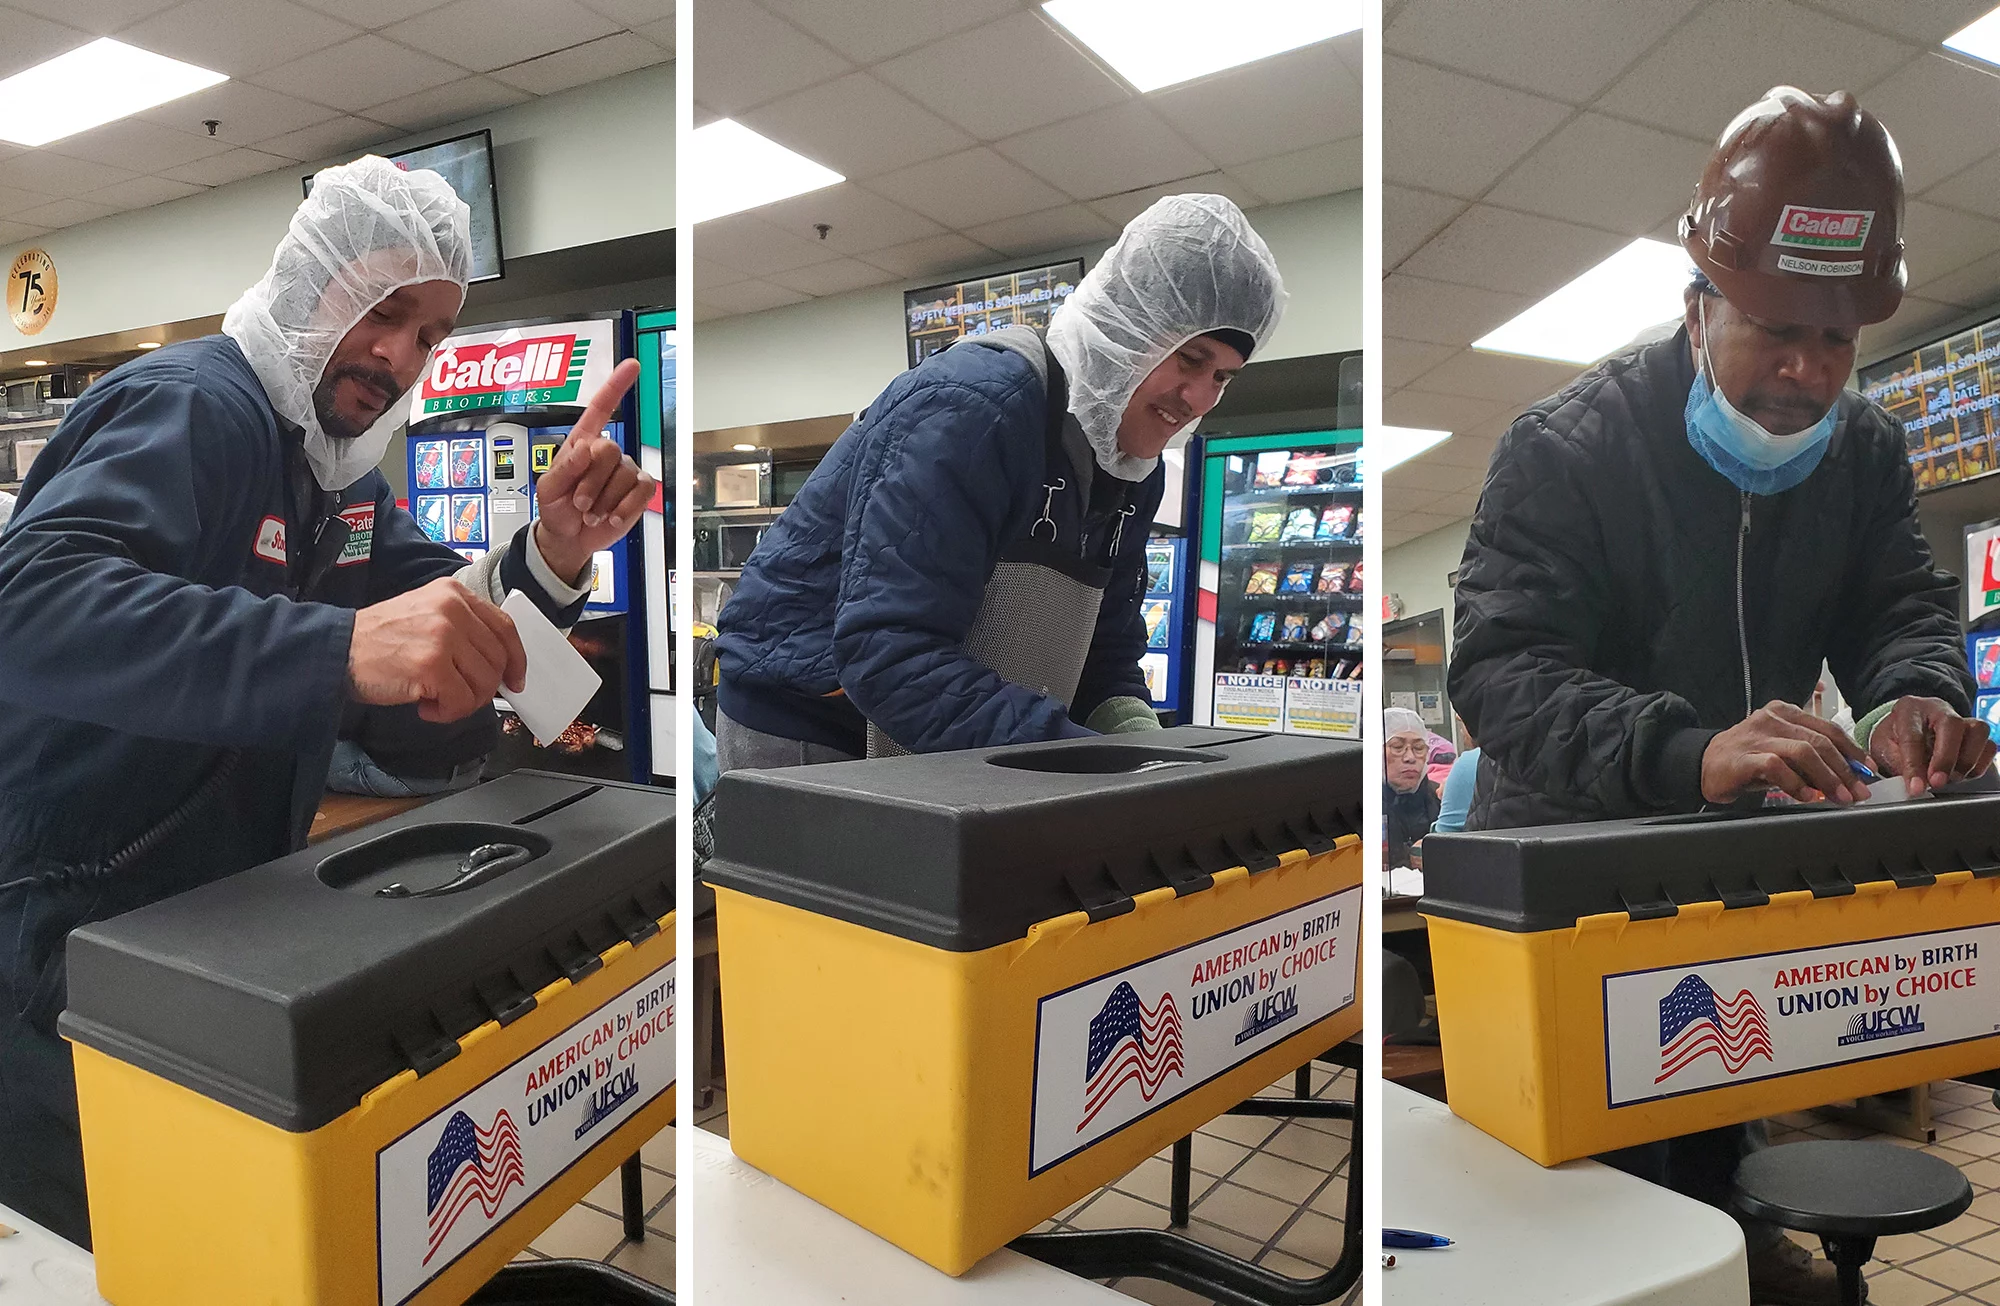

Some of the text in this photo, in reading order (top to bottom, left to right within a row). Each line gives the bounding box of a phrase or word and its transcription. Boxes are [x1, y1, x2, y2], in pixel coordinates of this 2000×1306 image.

[1789, 212, 1860, 236] Catelli
[11, 252, 50, 280] CELEBRATING
[1781, 258, 1862, 273] NELSON ROBINSON
[19, 270, 44, 315] 75
[911, 285, 1075, 324] SAFETY MEETING IS SCHEDULED FOR
[430, 342, 566, 393] Catelli
[1946, 361, 1957, 374] IS
[433, 389, 552, 412] BROTHERS
[1904, 393, 2000, 432] TUESDAY OCTOBER
[1953, 384, 1981, 403] DATE
[1228, 676, 1282, 688] NOTICE
[1300, 680, 1358, 693] NOTICE
[1190, 909, 1341, 988] AMERICAN by BIRTH
[1773, 942, 1979, 990] AMERICAN by BIRTH
[1191, 937, 1338, 1020] UNION by CHOICE
[1777, 967, 1977, 1017] UNION by CHOICE
[1255, 984, 1297, 1022] UFCW
[1861, 1003, 1920, 1030] UFCW
[525, 976, 676, 1097] AMERICAN by BIRTH
[1845, 1034, 1865, 1043] VOICE
[1875, 1028, 1898, 1038] working
[1899, 1025, 1922, 1034] America
[527, 1063, 591, 1127] UNION
[594, 1053, 614, 1081] by
[617, 1004, 675, 1061] CHOICE
[592, 1062, 636, 1111] UFCW
